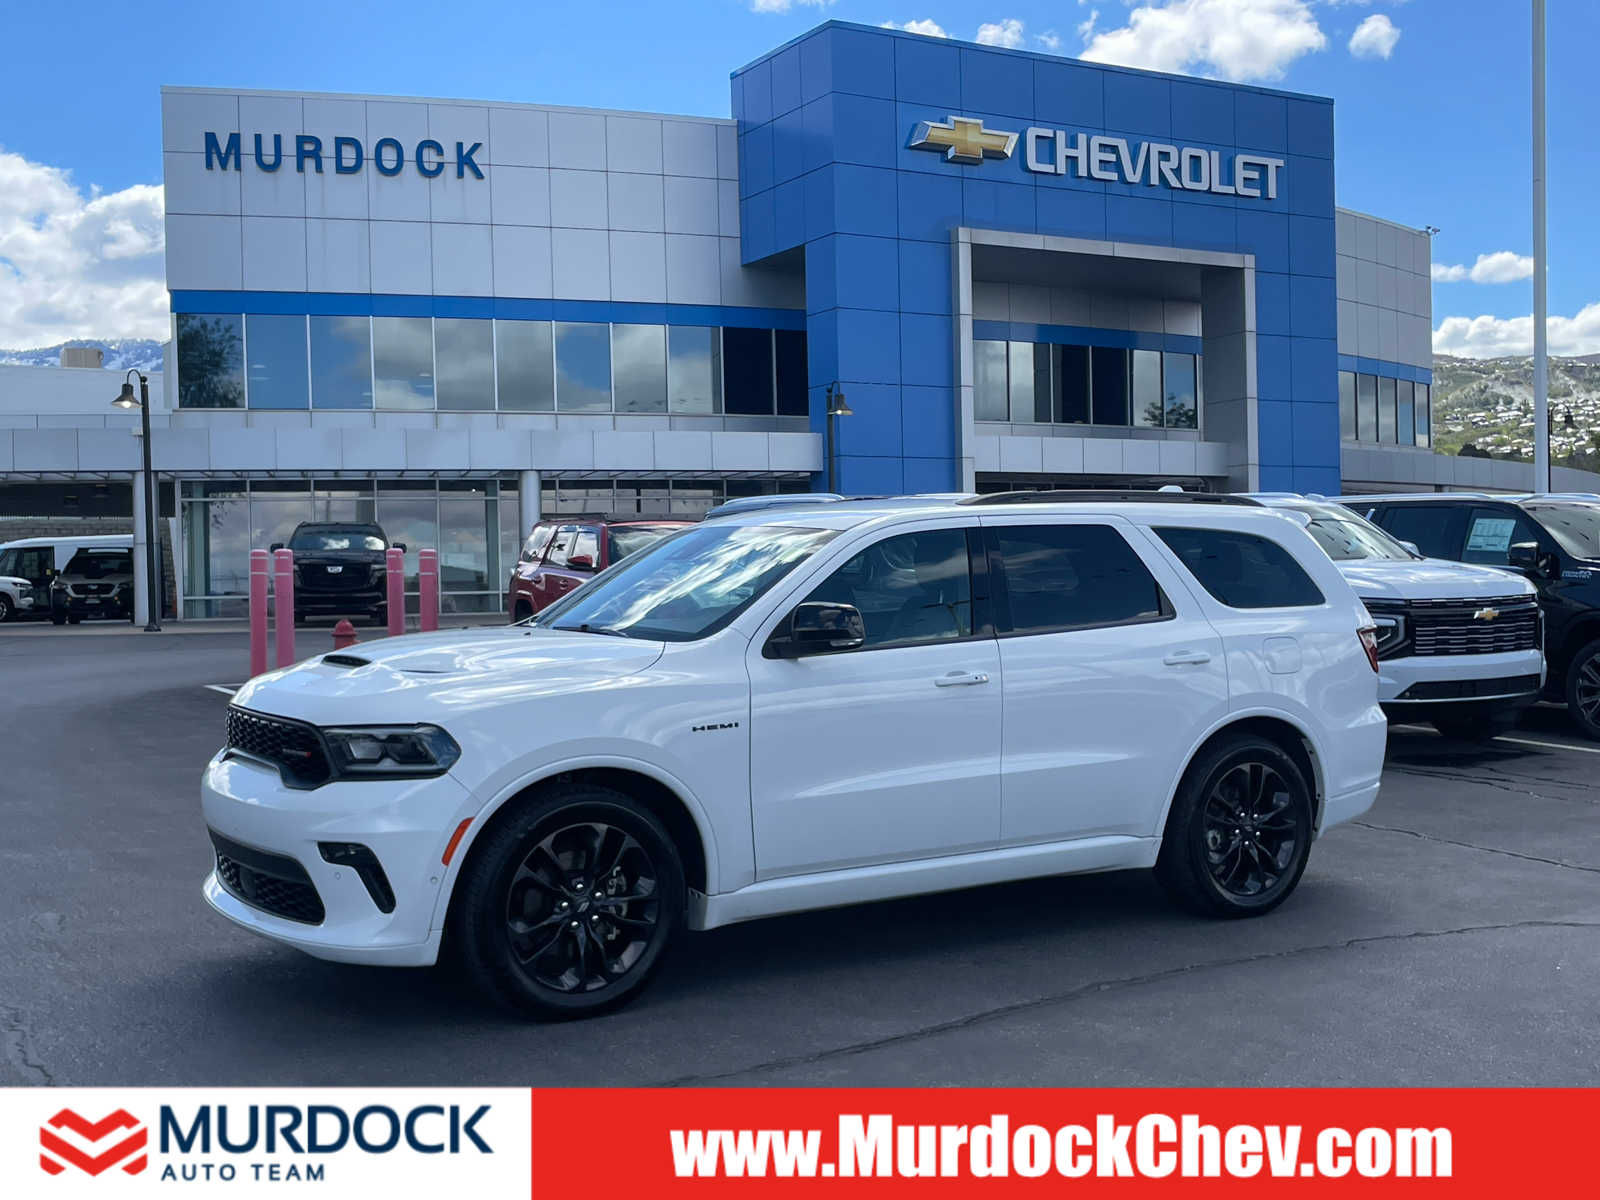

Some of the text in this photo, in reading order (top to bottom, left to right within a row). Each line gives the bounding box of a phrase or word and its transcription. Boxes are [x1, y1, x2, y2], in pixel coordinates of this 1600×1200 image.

[204, 131, 485, 180] MURDOCK
[1025, 126, 1285, 200] CHEVROLET
[691, 721, 740, 733] HEMI
